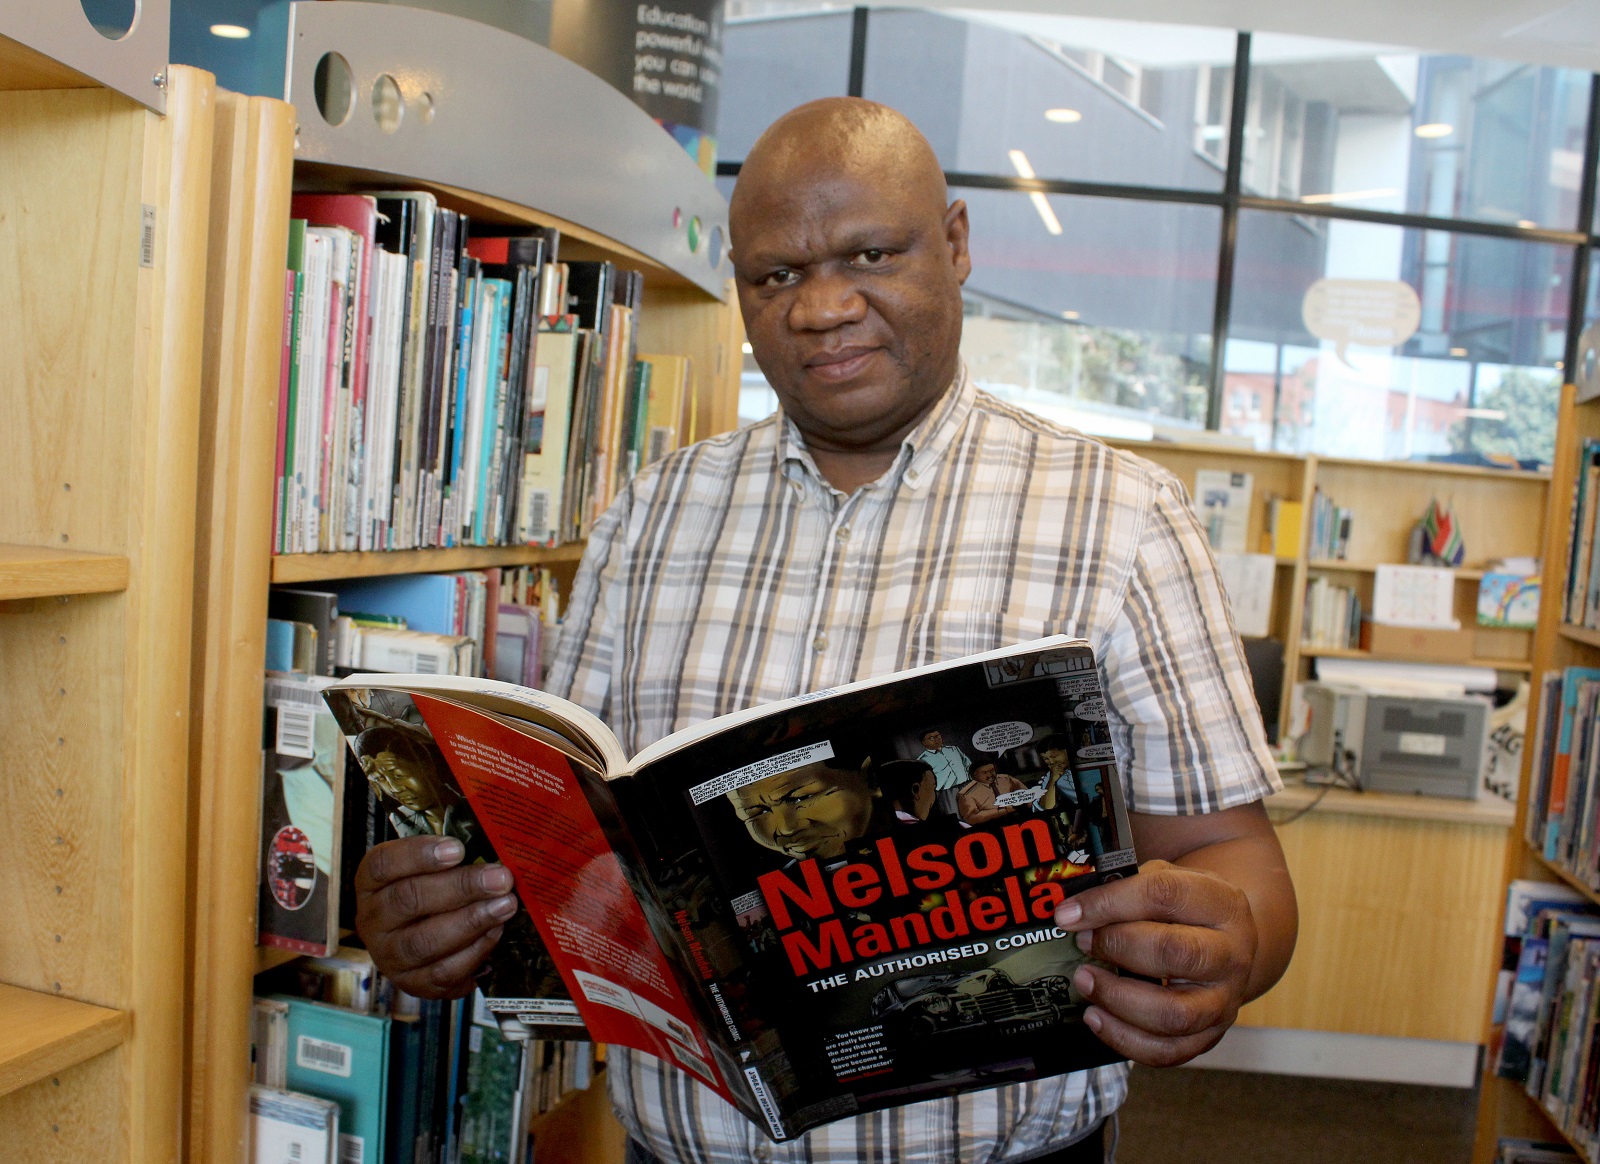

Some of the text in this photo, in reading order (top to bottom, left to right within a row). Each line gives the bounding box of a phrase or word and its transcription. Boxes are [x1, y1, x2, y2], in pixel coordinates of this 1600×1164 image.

[635, 54, 666, 73] you
[670, 59, 698, 77] can
[757, 819, 1056, 931] Nelson
[780, 877, 1065, 977] Mandela
[807, 926, 1067, 993] THE AUTHORISED COMIC
[675, 910, 741, 1041] Nelson Mandela THE AUTHORISED COMIC
[838, 1038, 857, 1047] really
[858, 1032, 883, 1041] famous
[849, 1028, 869, 1036] know
[831, 1053, 859, 1063] discover
[850, 1056, 877, 1065] become
[836, 1069, 856, 1077] comic
